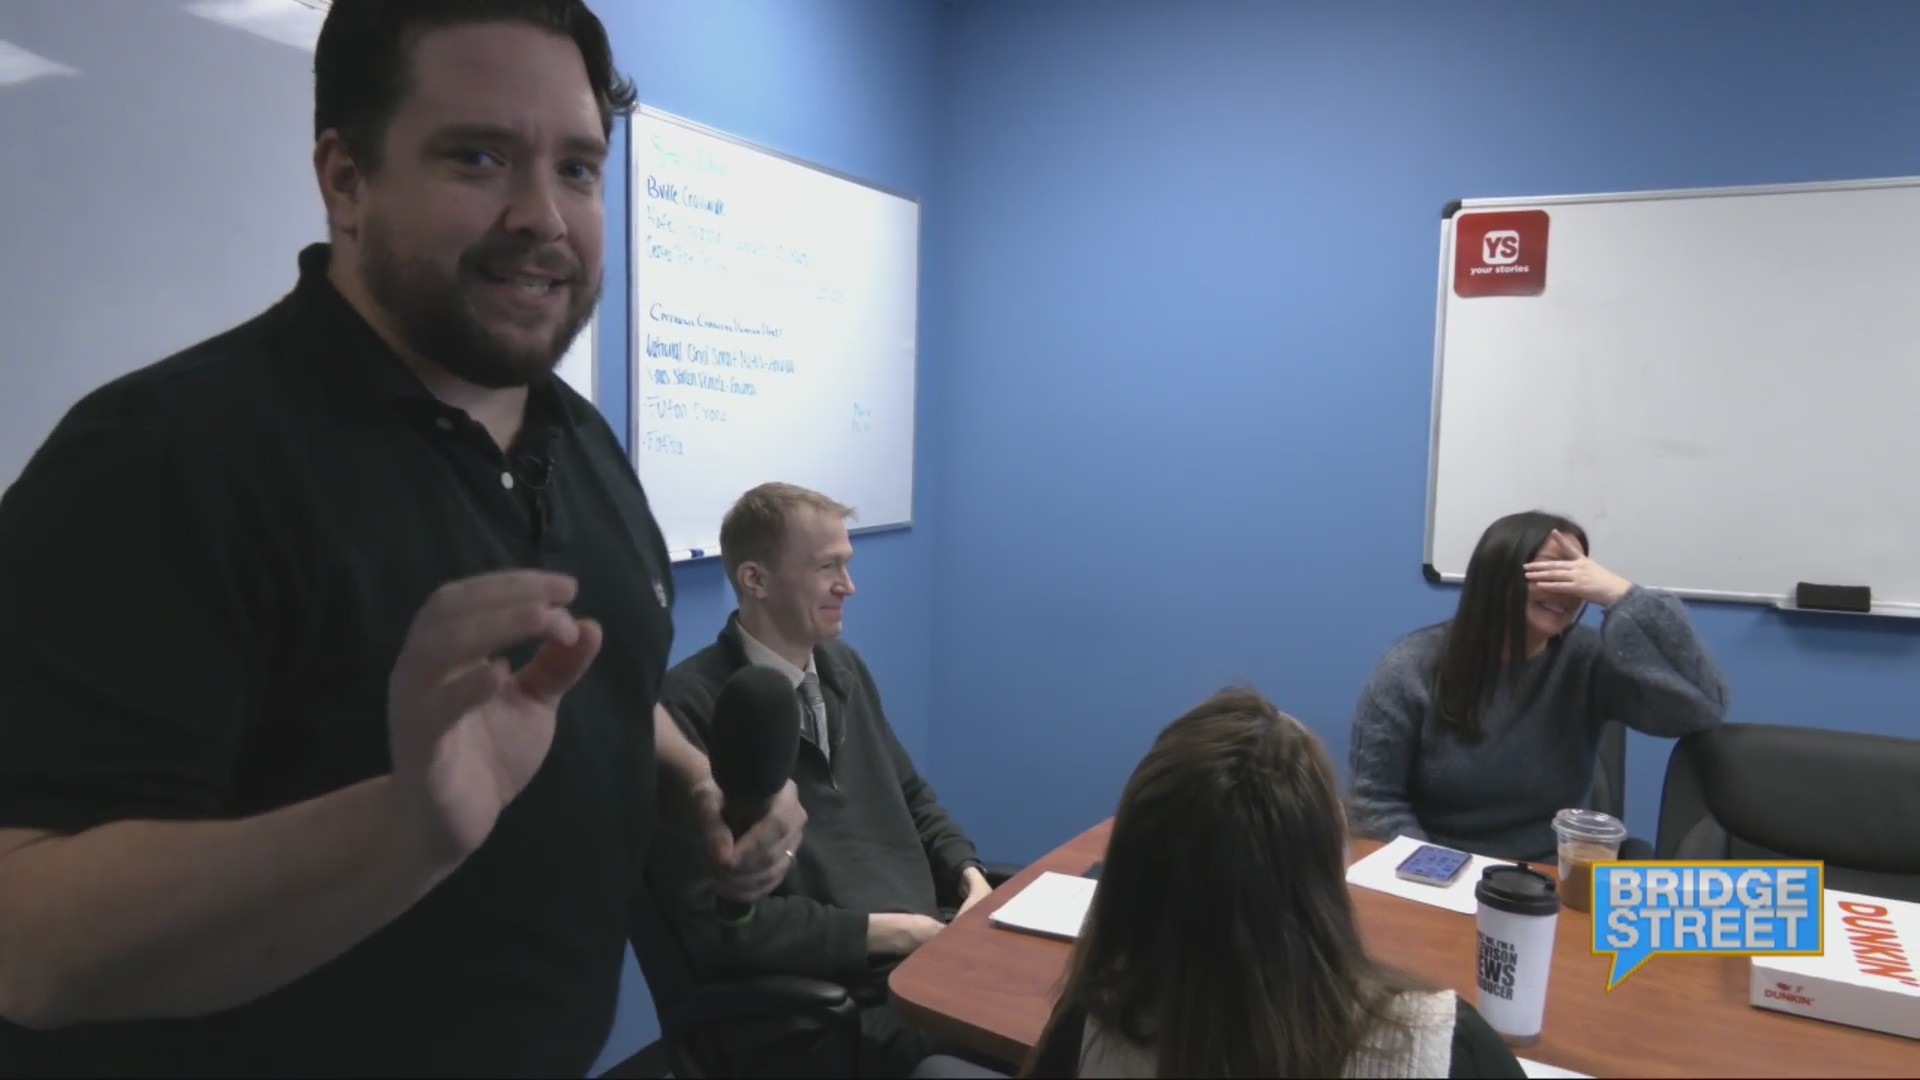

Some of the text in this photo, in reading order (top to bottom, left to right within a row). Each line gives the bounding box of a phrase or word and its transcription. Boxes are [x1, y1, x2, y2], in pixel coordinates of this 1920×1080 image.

[1485, 236, 1518, 258] YS
[1470, 264, 1530, 276] your stories
[1509, 943, 1515, 951] A
[1478, 953, 1516, 987] EWS
